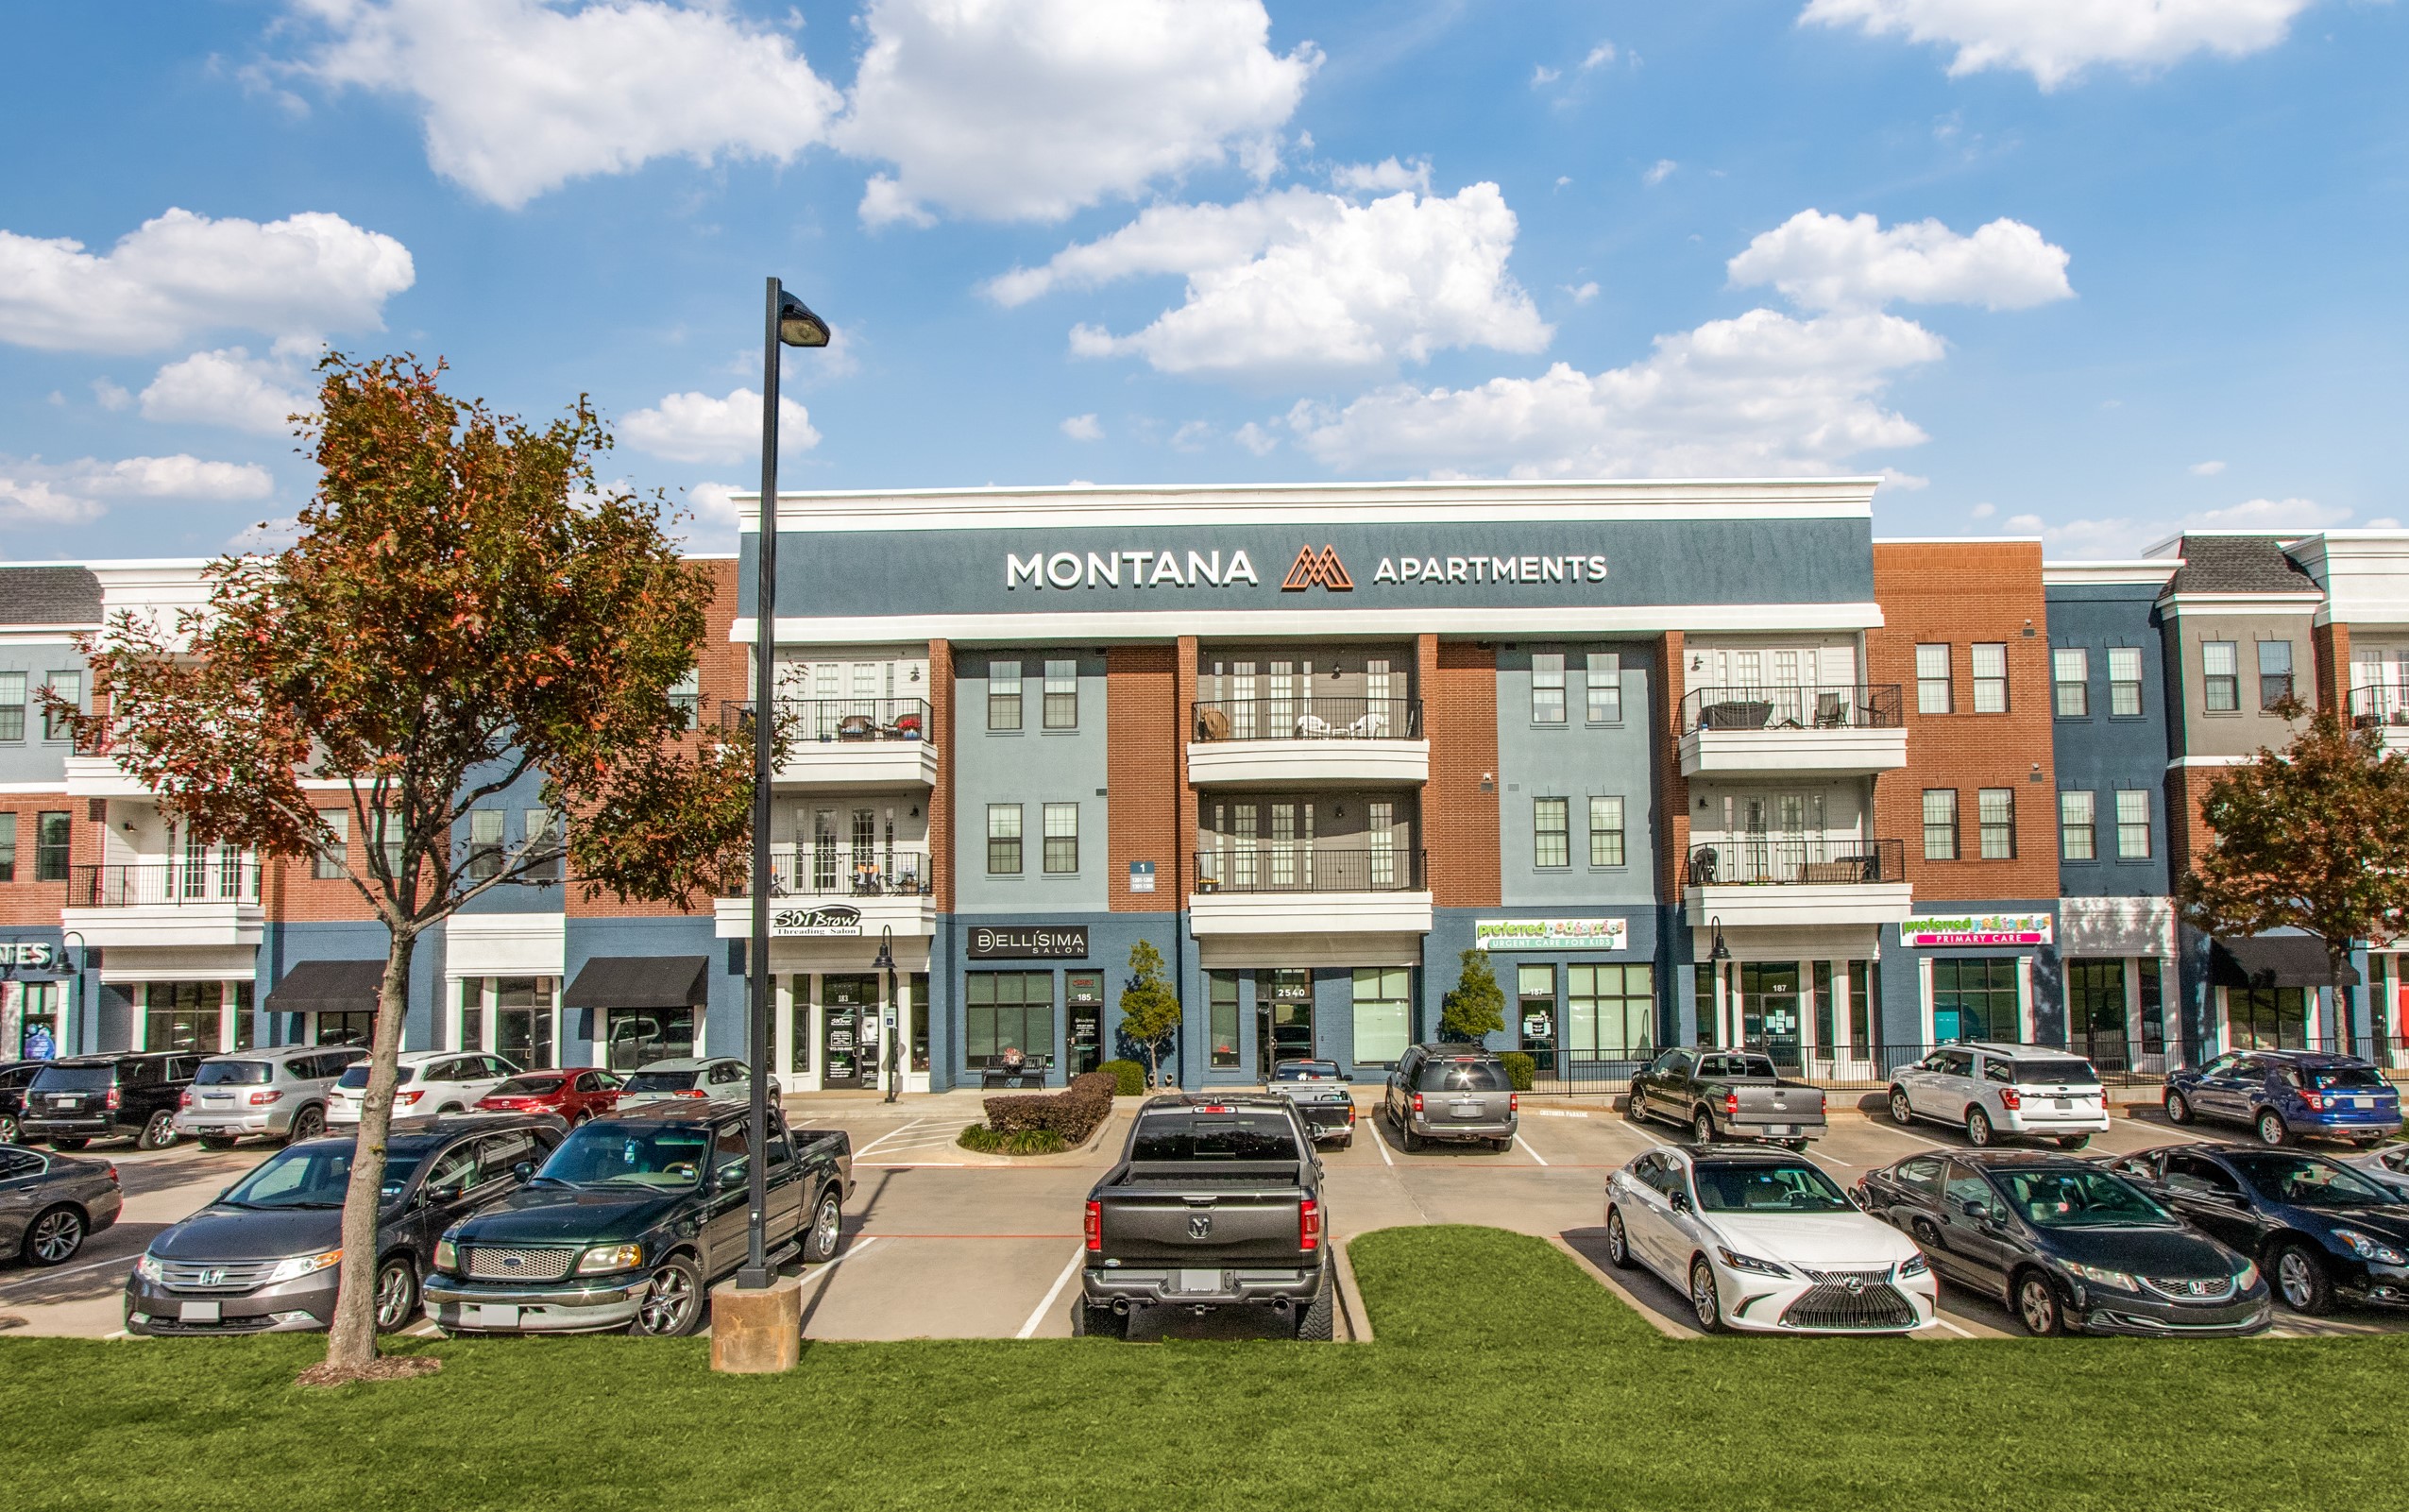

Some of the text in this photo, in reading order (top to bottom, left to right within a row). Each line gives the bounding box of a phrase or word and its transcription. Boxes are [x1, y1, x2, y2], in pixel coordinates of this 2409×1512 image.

[1007, 551, 1608, 590] MONTANA APARTMENTS
[1140, 863, 1145, 873] 1
[1492, 939, 1531, 947] URGENT
[1535, 939, 1561, 947] CARE
[1992, 934, 2022, 943] CARE
[1278, 989, 1305, 997] 2540
